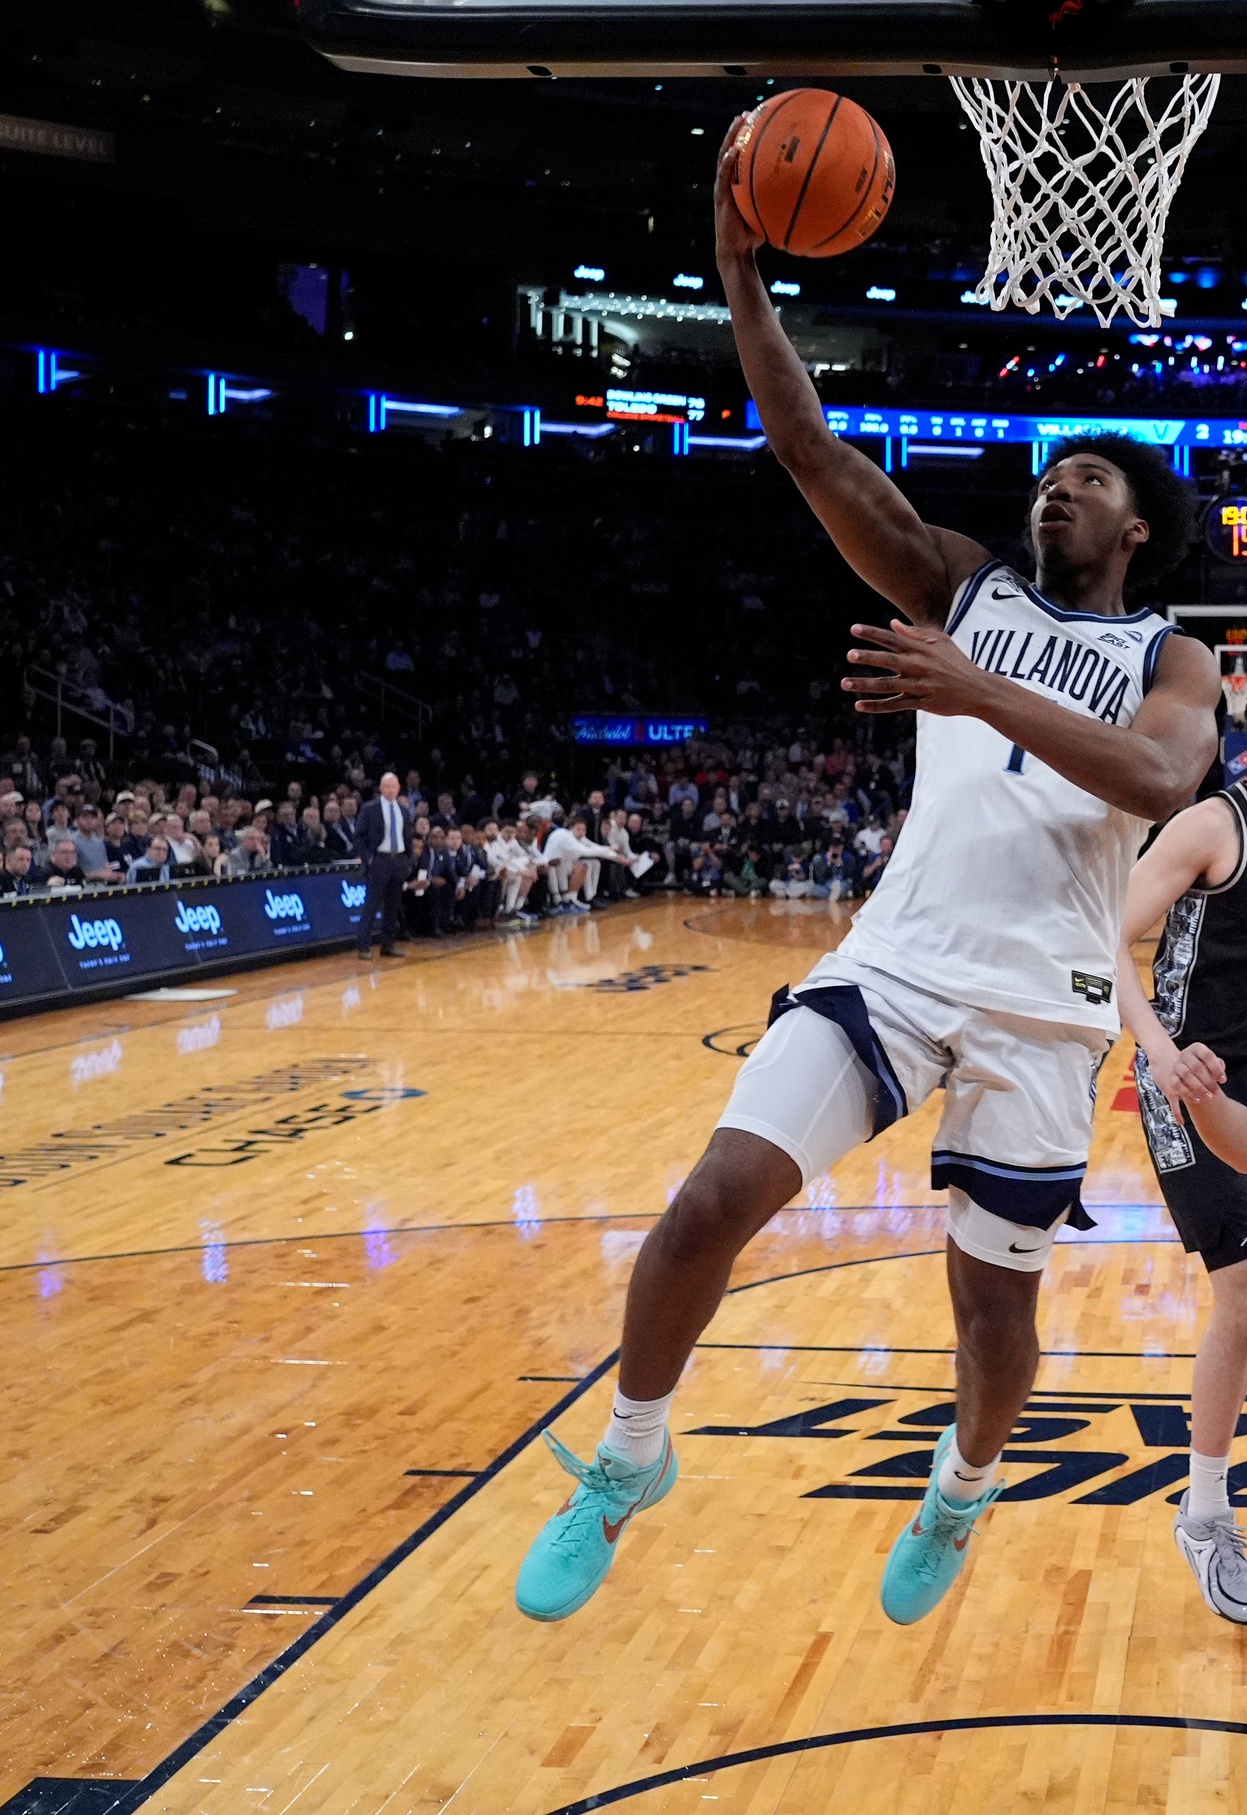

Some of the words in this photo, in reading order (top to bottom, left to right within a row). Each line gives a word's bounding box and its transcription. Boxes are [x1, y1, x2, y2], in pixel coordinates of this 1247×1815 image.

[1196, 424, 1210, 440] 2
[971, 629, 1131, 725] VILLANOVA
[175, 900, 220, 935] Jeep
[264, 889, 305, 921] Jeep
[68, 914, 123, 951] Jeep
